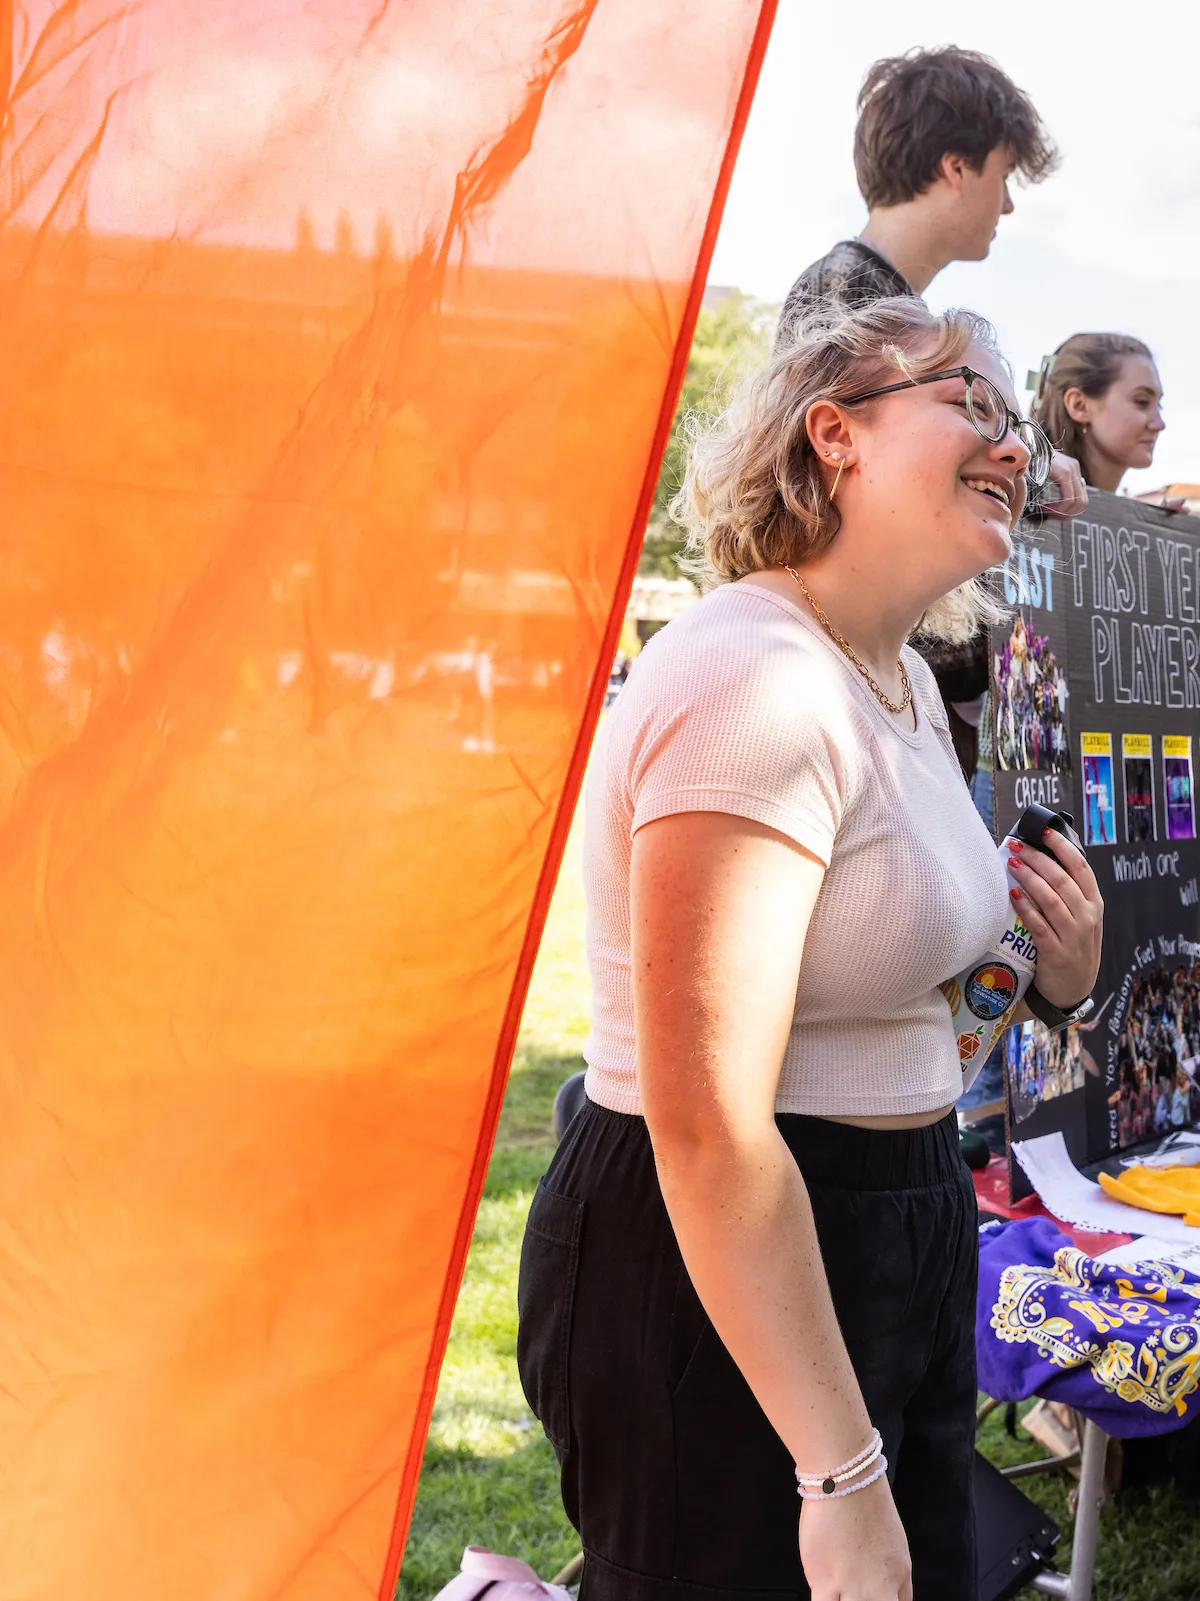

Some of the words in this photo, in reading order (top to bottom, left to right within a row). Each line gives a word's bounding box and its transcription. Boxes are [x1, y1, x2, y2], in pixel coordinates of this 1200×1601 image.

[1003, 543, 1055, 612] CAST
[1071, 519, 1150, 615] FIRST
[1014, 776, 1060, 809] CREATE
[1112, 851, 1152, 882] Which
[1156, 850, 1180, 877] one
[1000, 929, 1037, 965] PRID
